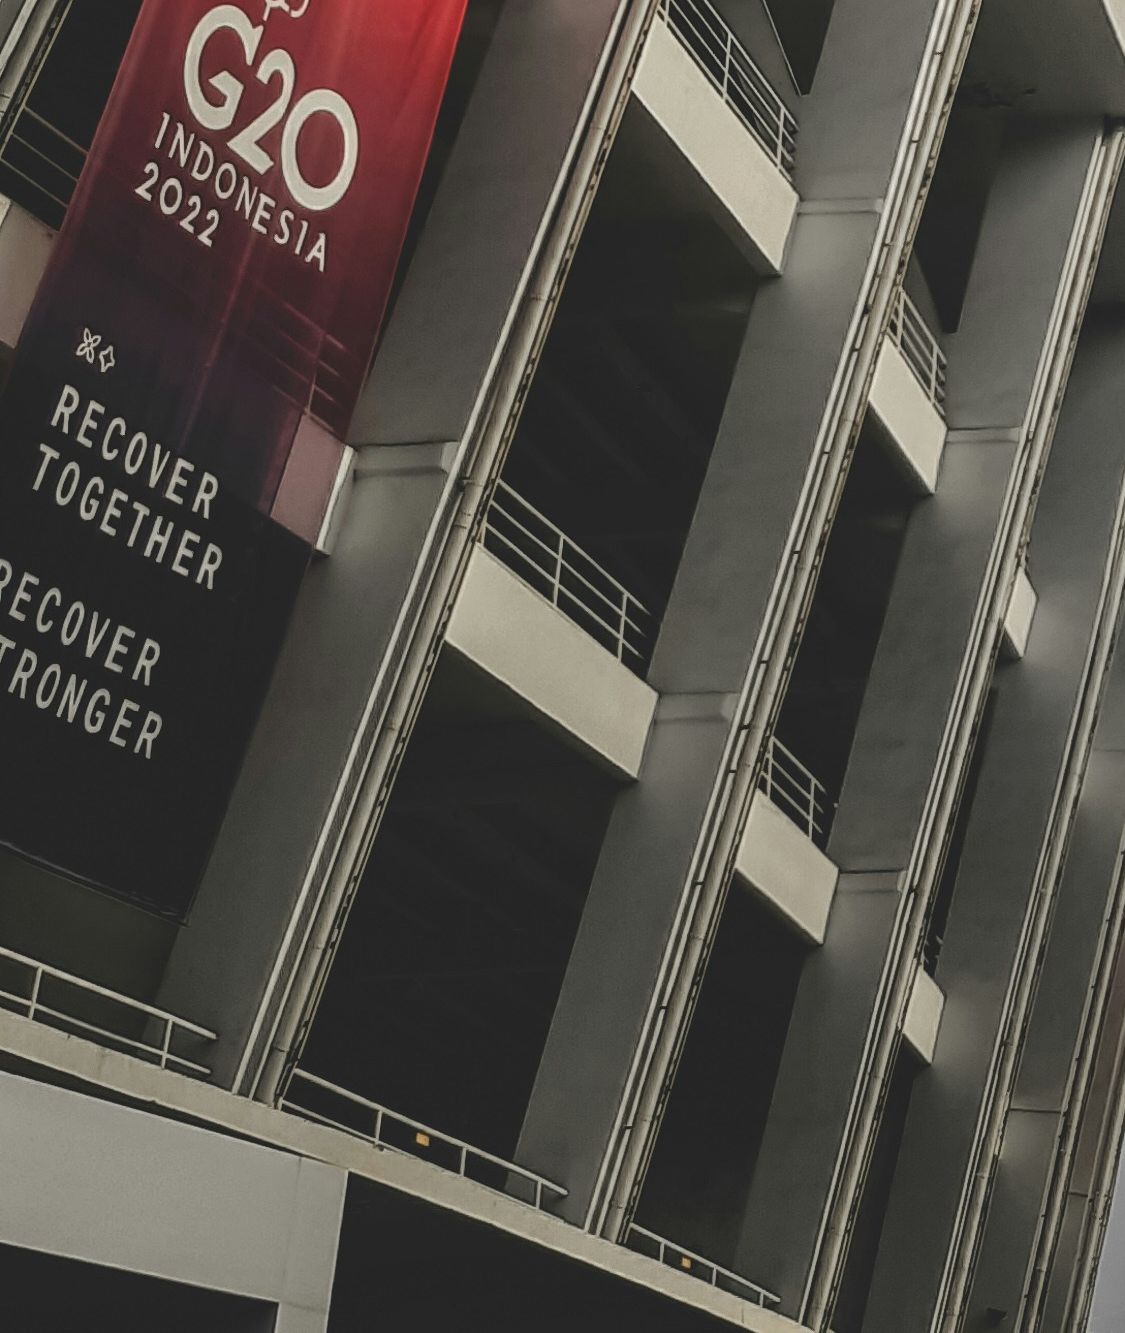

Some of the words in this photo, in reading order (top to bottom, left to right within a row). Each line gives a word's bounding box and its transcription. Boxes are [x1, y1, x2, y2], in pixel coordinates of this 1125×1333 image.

[183, 4, 359, 211] G20
[134, 161, 220, 248] 2022
[154, 111, 326, 273] INDONESIA
[32, 443, 223, 590] TOGETHER
[50, 384, 219, 520] RECOVER
